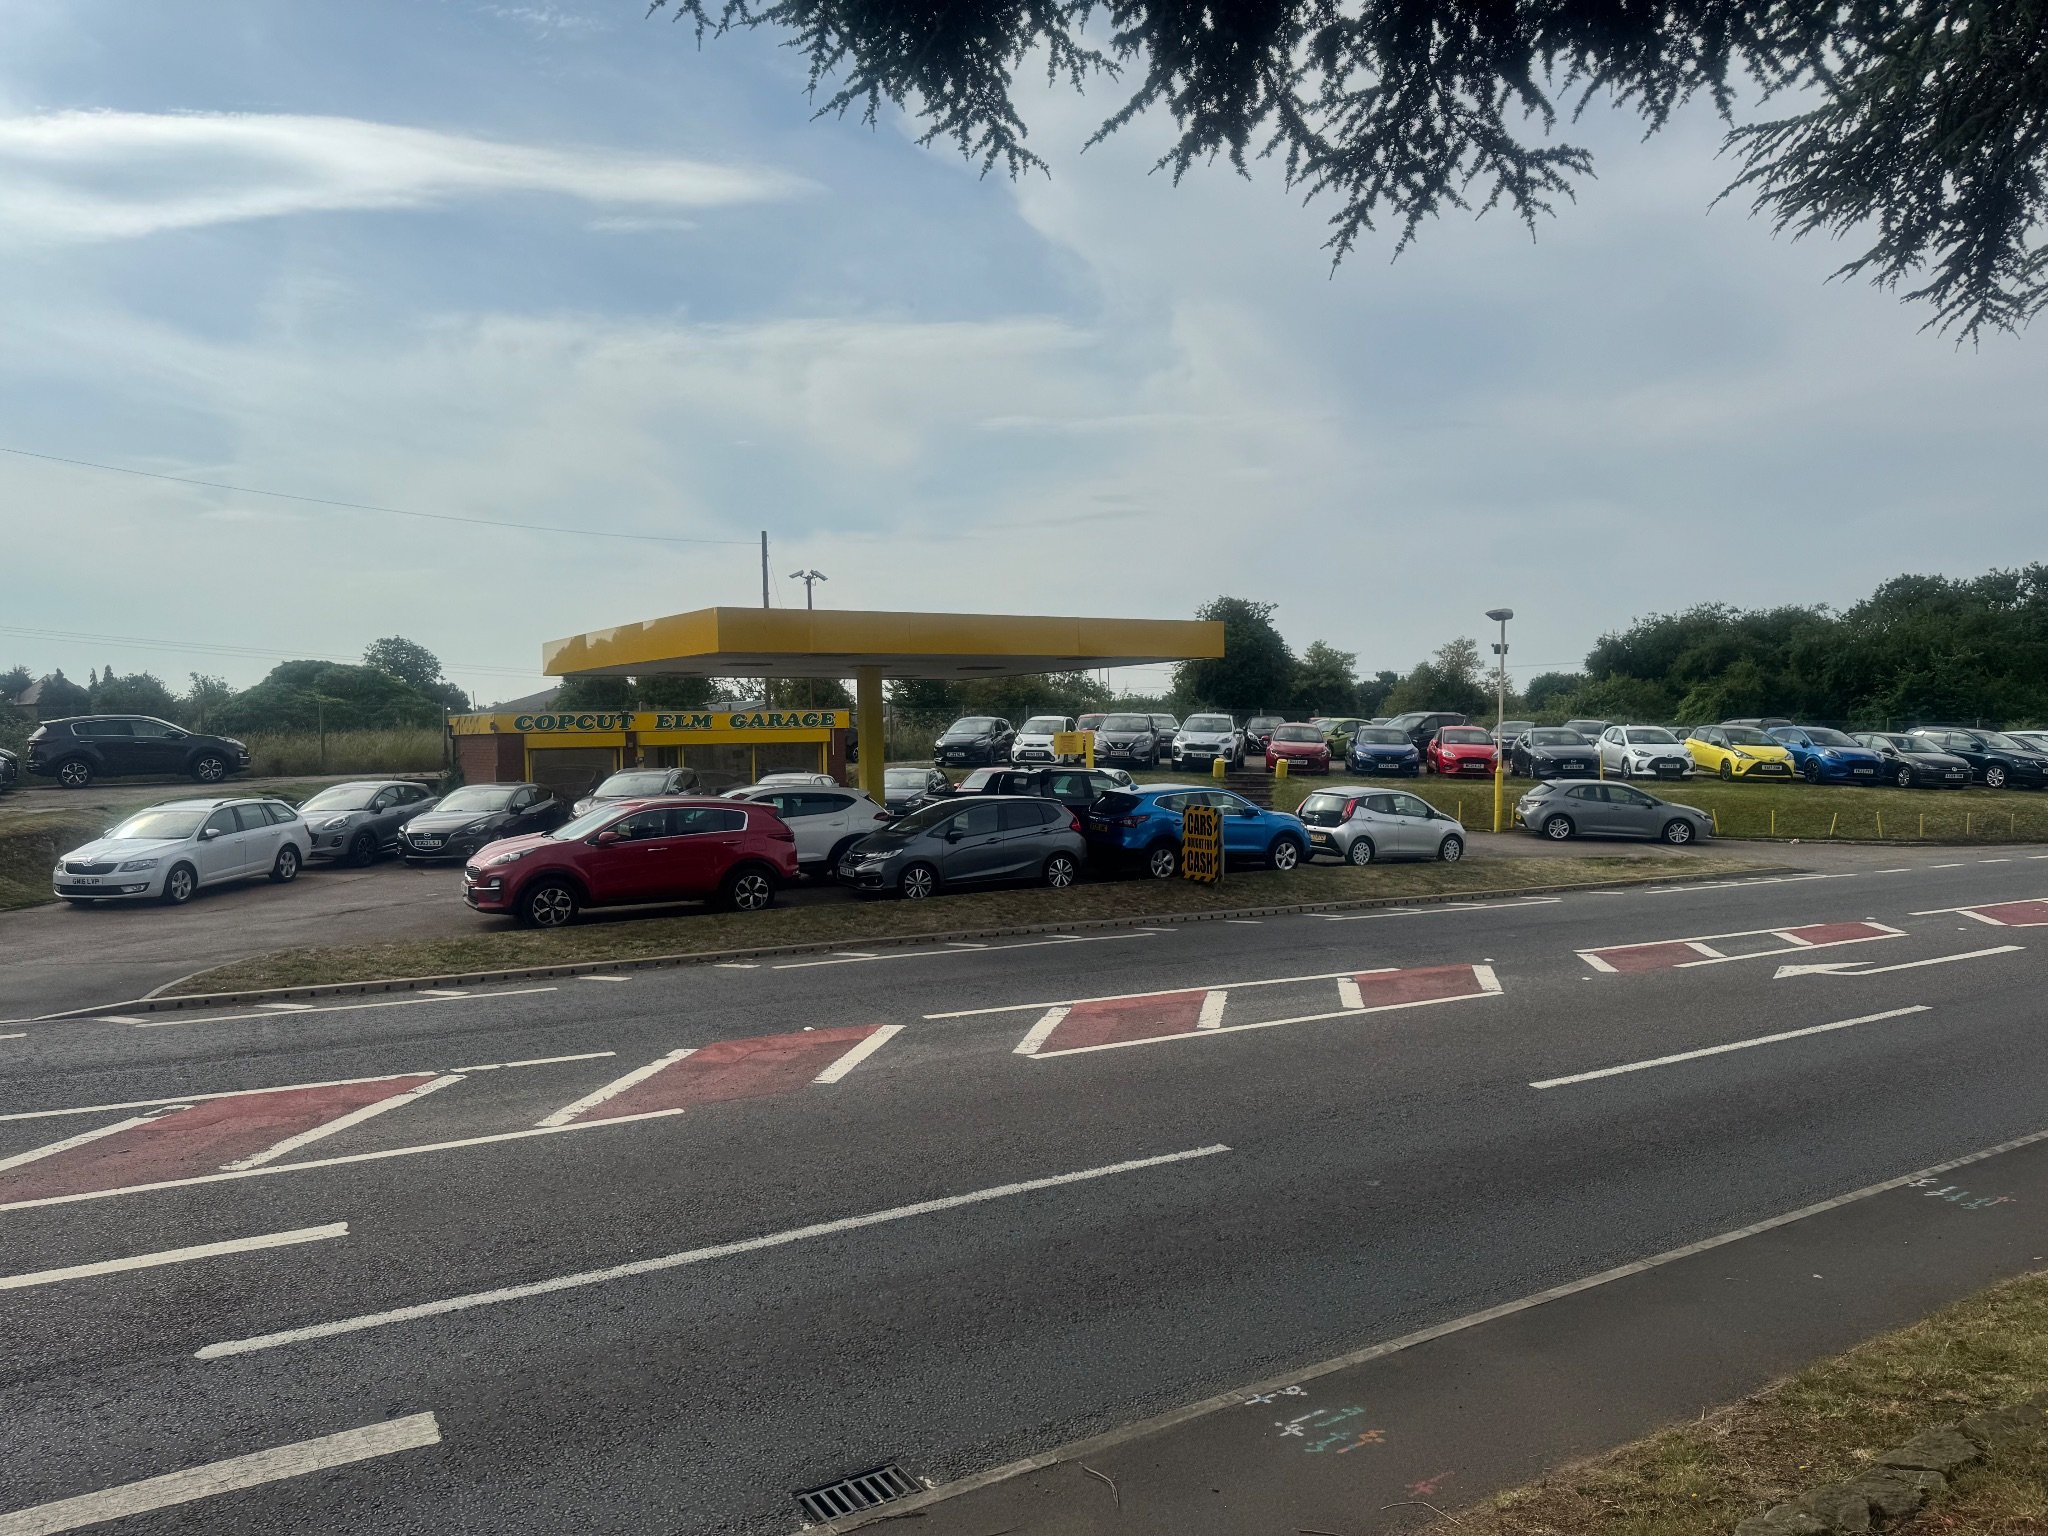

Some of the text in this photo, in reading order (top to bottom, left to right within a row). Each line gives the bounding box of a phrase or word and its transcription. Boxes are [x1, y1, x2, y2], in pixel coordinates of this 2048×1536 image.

[513, 712, 836, 731] COPCUT ELM GARAGE
[1187, 812, 1213, 837] CARS
[1187, 849, 1213, 875] CASH
